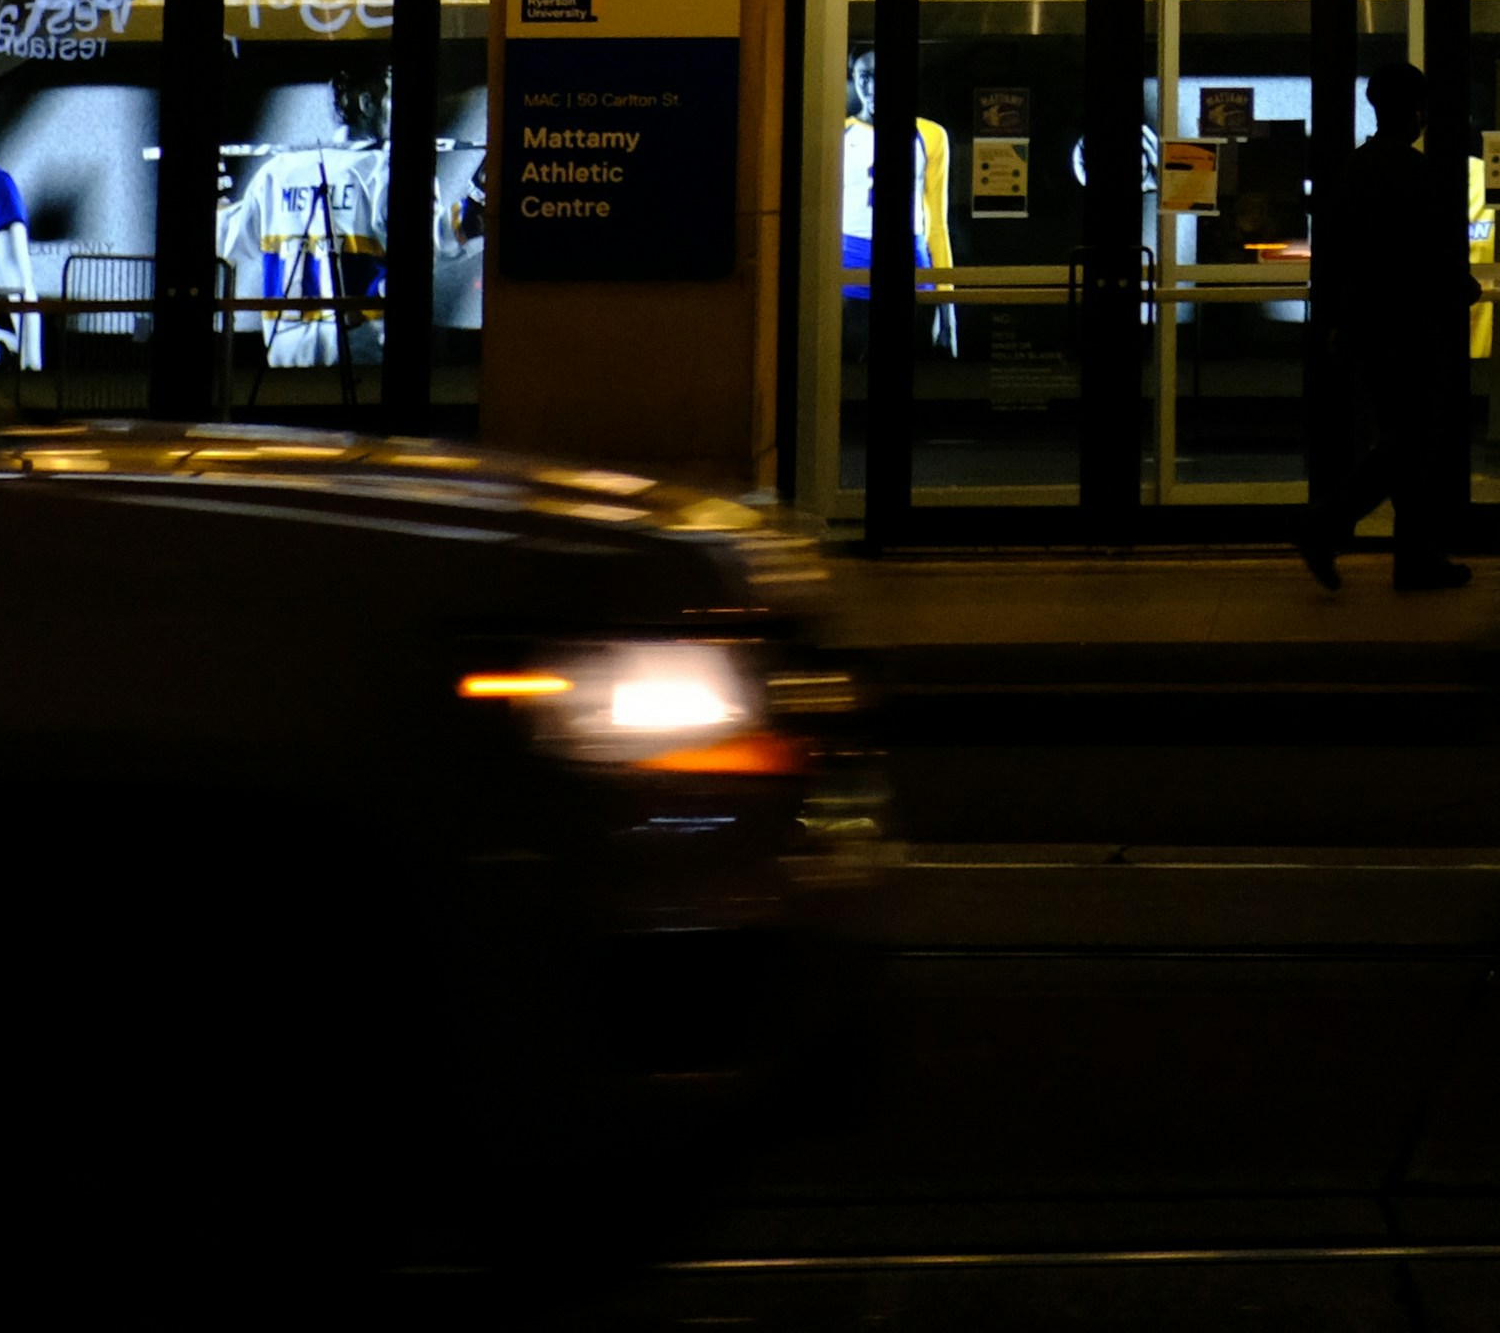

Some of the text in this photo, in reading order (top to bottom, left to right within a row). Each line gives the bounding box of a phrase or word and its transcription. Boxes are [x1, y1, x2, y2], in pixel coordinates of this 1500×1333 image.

[526, 7, 589, 21] University
[523, 92, 562, 108] MAC
[576, 92, 598, 108] 50
[601, 92, 657, 108] Carlton
[522, 125, 641, 153] Mattamy
[520, 160, 625, 184] Athletic
[281, 184, 356, 212] MISTLE
[520, 196, 612, 219] Centre
